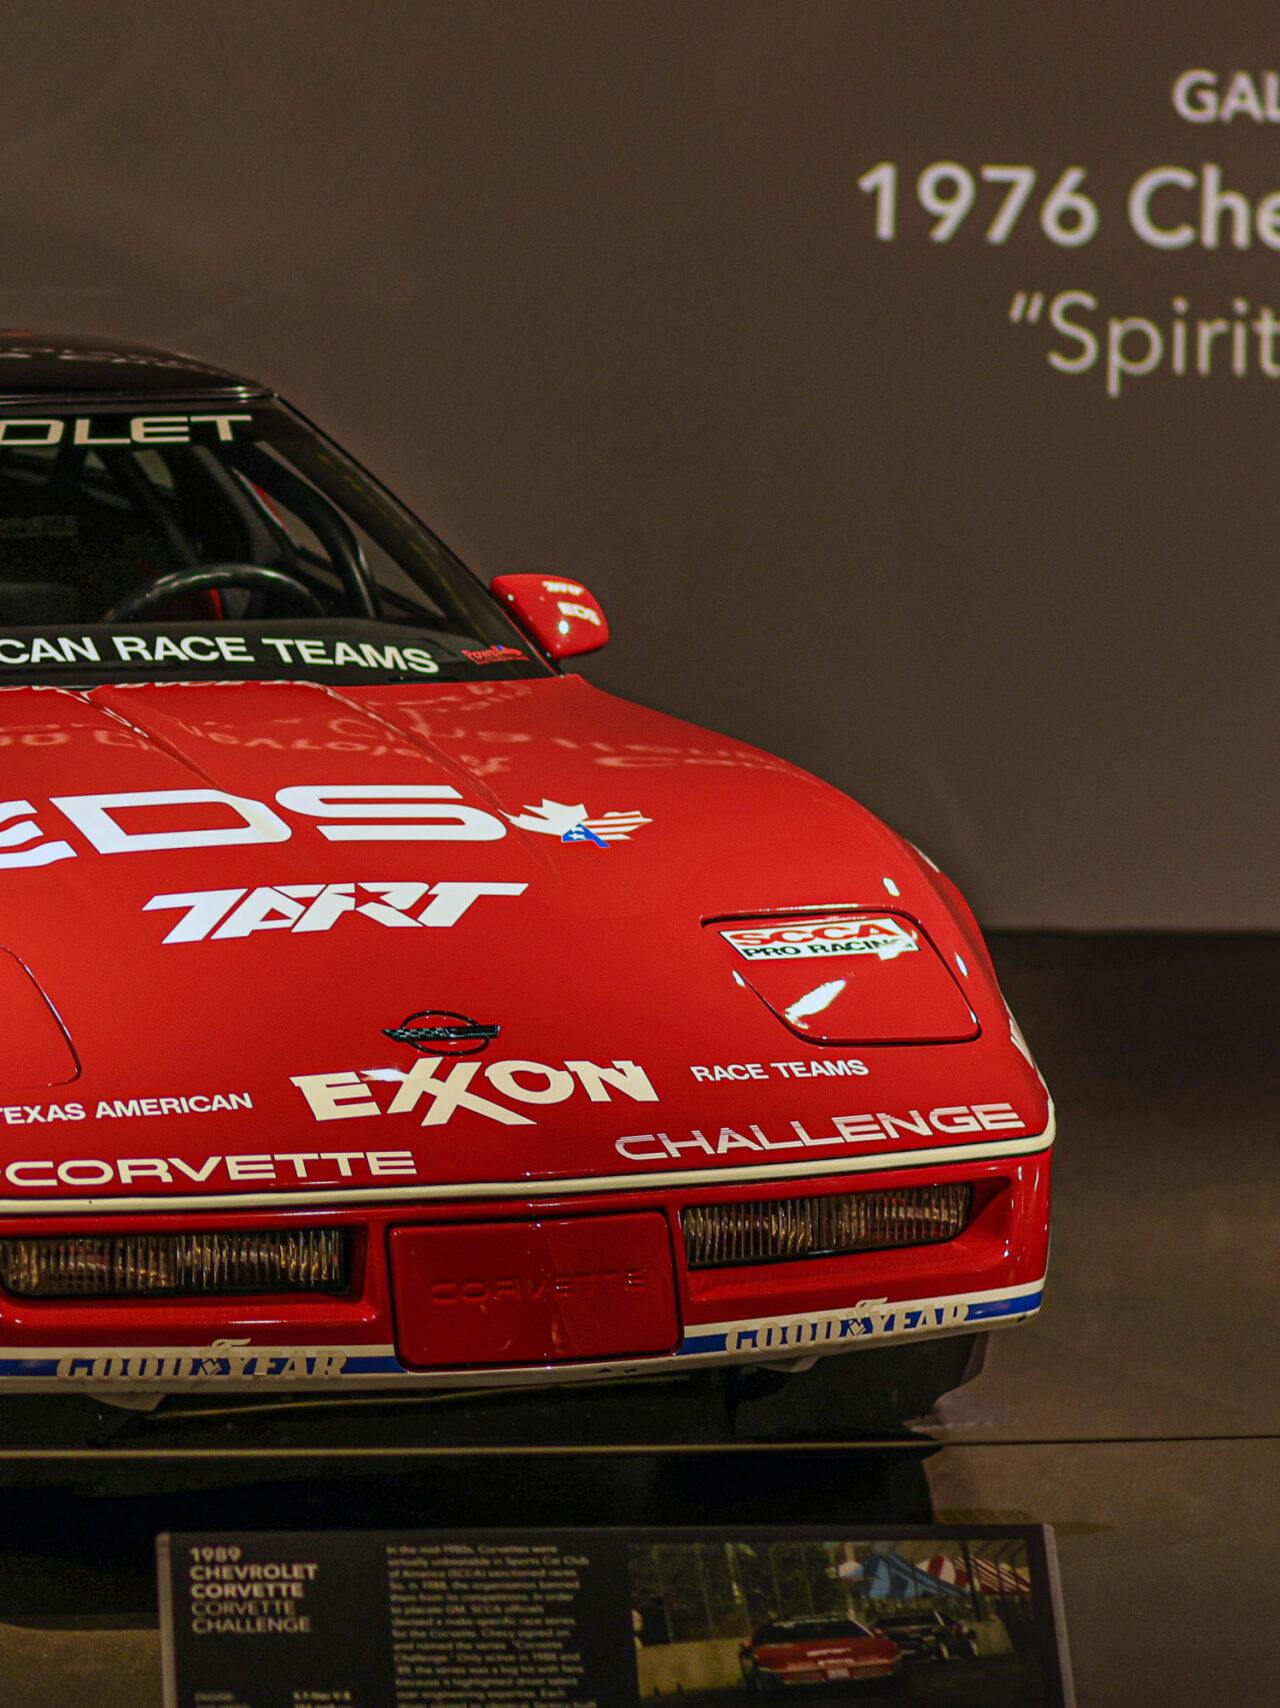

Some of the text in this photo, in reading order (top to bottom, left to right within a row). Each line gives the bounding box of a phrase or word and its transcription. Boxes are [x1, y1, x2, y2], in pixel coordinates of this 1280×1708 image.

[858, 160, 1099, 248] 1976
[111, 635, 254, 664] RACE
[261, 637, 440, 674] TEAMS
[729, 923, 900, 946] SCCA
[741, 938, 913, 958] PRO RACIN
[690, 1059, 869, 1082] RACE TEAMS
[290, 1057, 659, 1126] EXXON
[95, 1092, 253, 1119] AMERICAN
[615, 1103, 1025, 1161] CHALLENGE
[5, 1151, 417, 1187] CORVETTE
[190, 1546, 241, 1563] 1989
[190, 1562, 318, 1581] CHEVROLET
[191, 1582, 304, 1599] CORVETTE
[191, 1599, 296, 1616] CORVETTE
[192, 1616, 311, 1634] CHALLENGE
